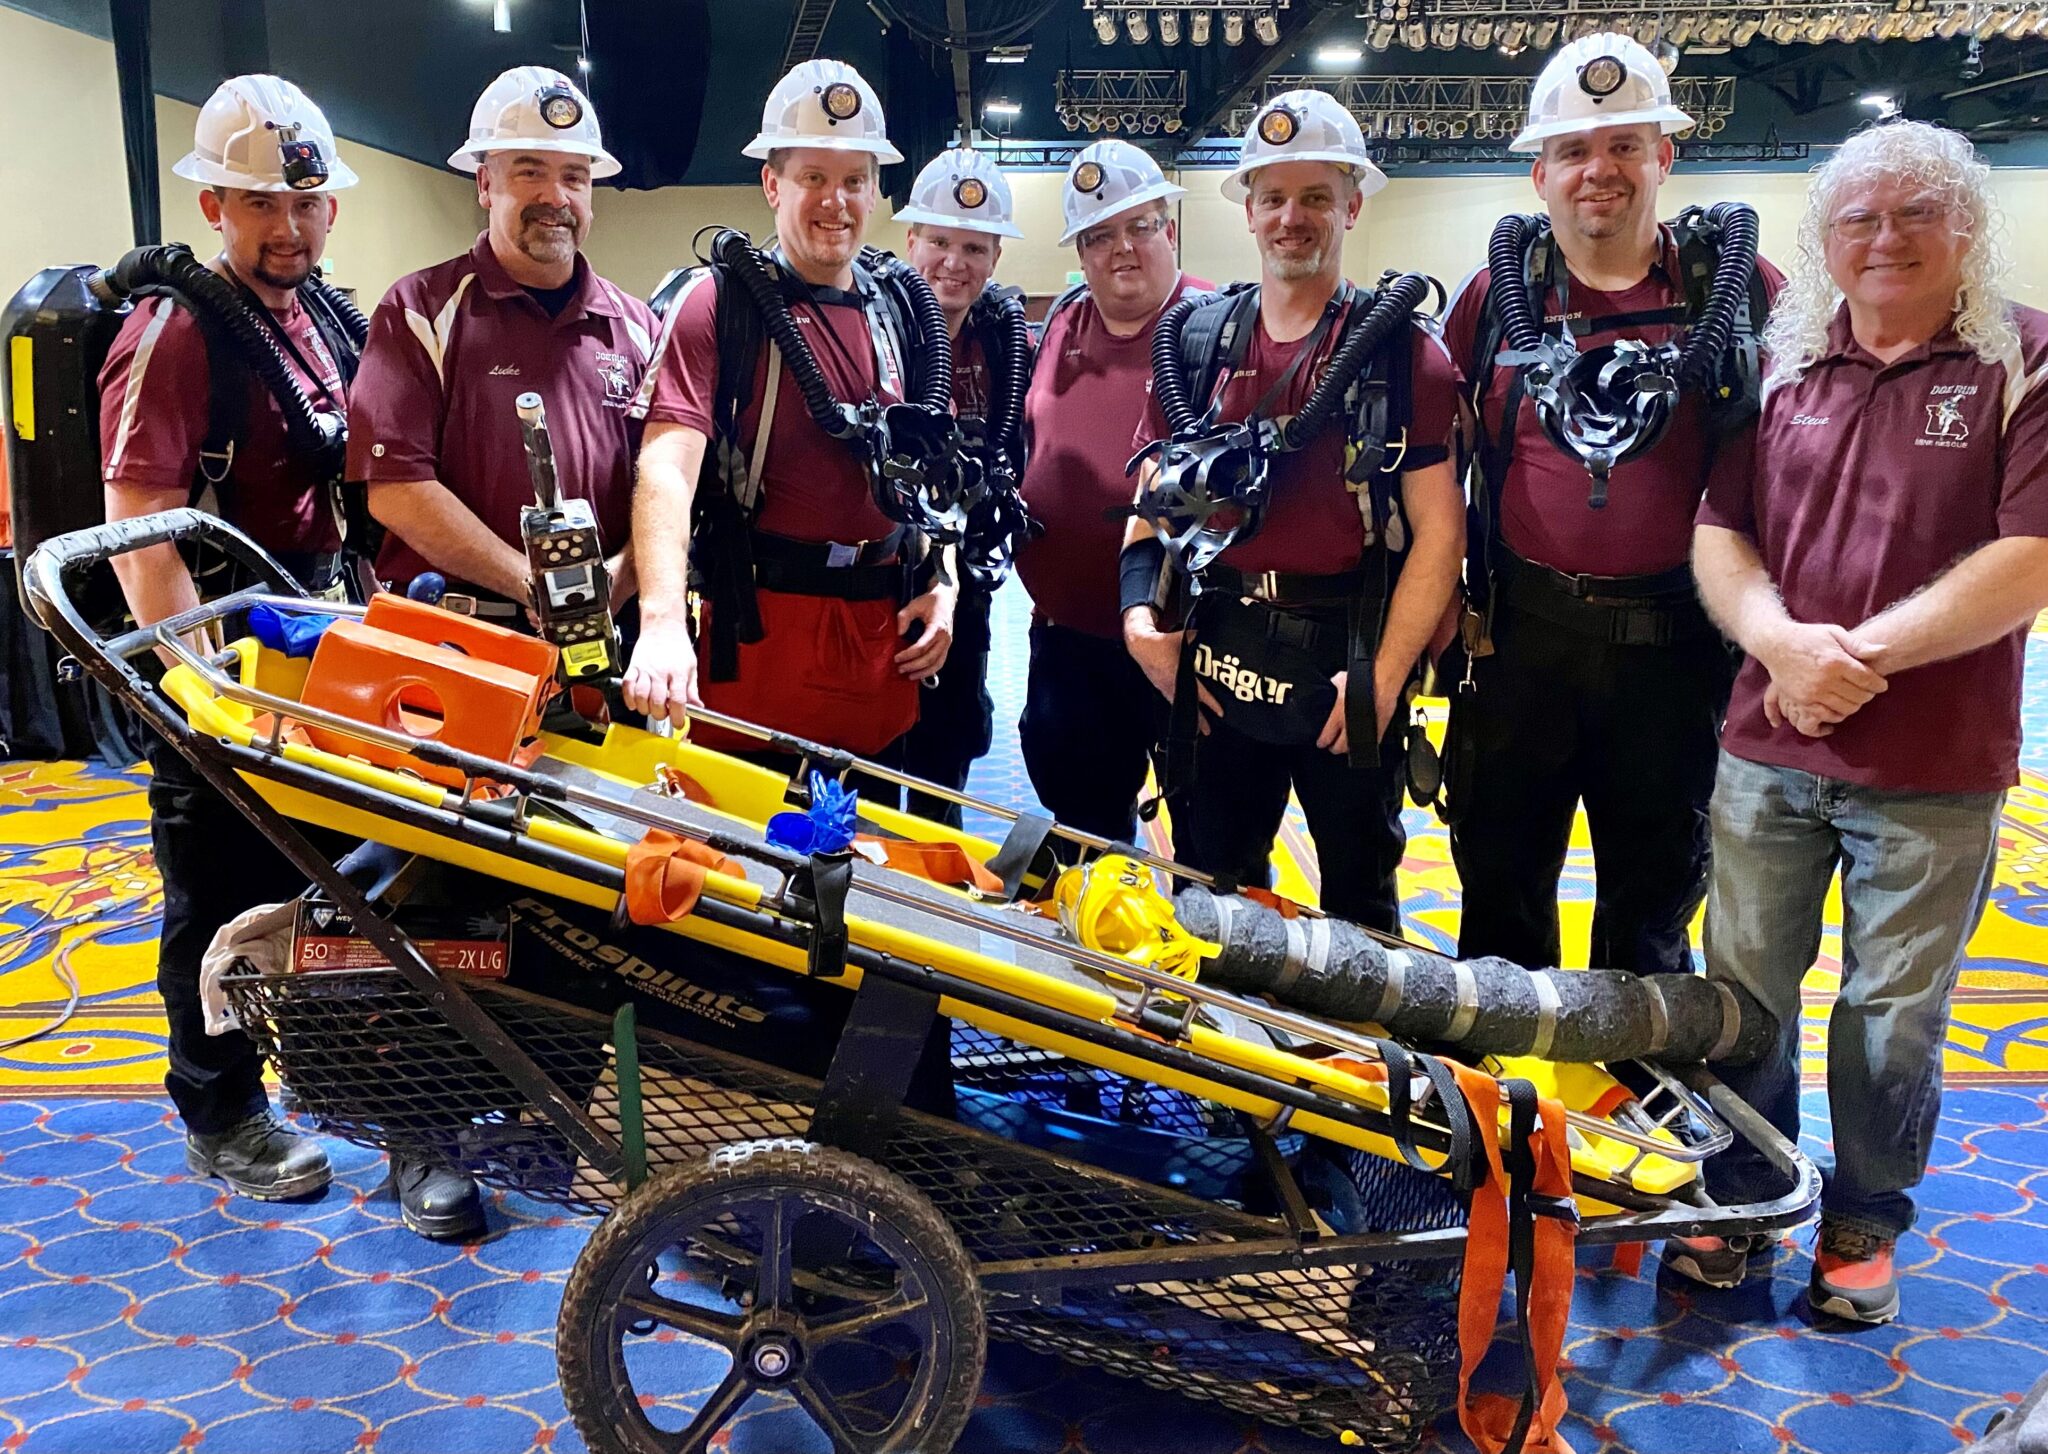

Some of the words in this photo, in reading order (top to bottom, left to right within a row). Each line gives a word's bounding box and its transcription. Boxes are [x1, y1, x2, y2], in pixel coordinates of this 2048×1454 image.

[1930, 385, 1954, 395] DOE
[1953, 385, 1978, 395] RUN
[1790, 414, 1830, 426] Steve
[1935, 440, 1969, 449] RESCUE
[1194, 643, 1293, 704] Dräger
[304, 943, 328, 960] 50
[458, 950, 476, 969] 2X
[480, 950, 501, 970] L/G
